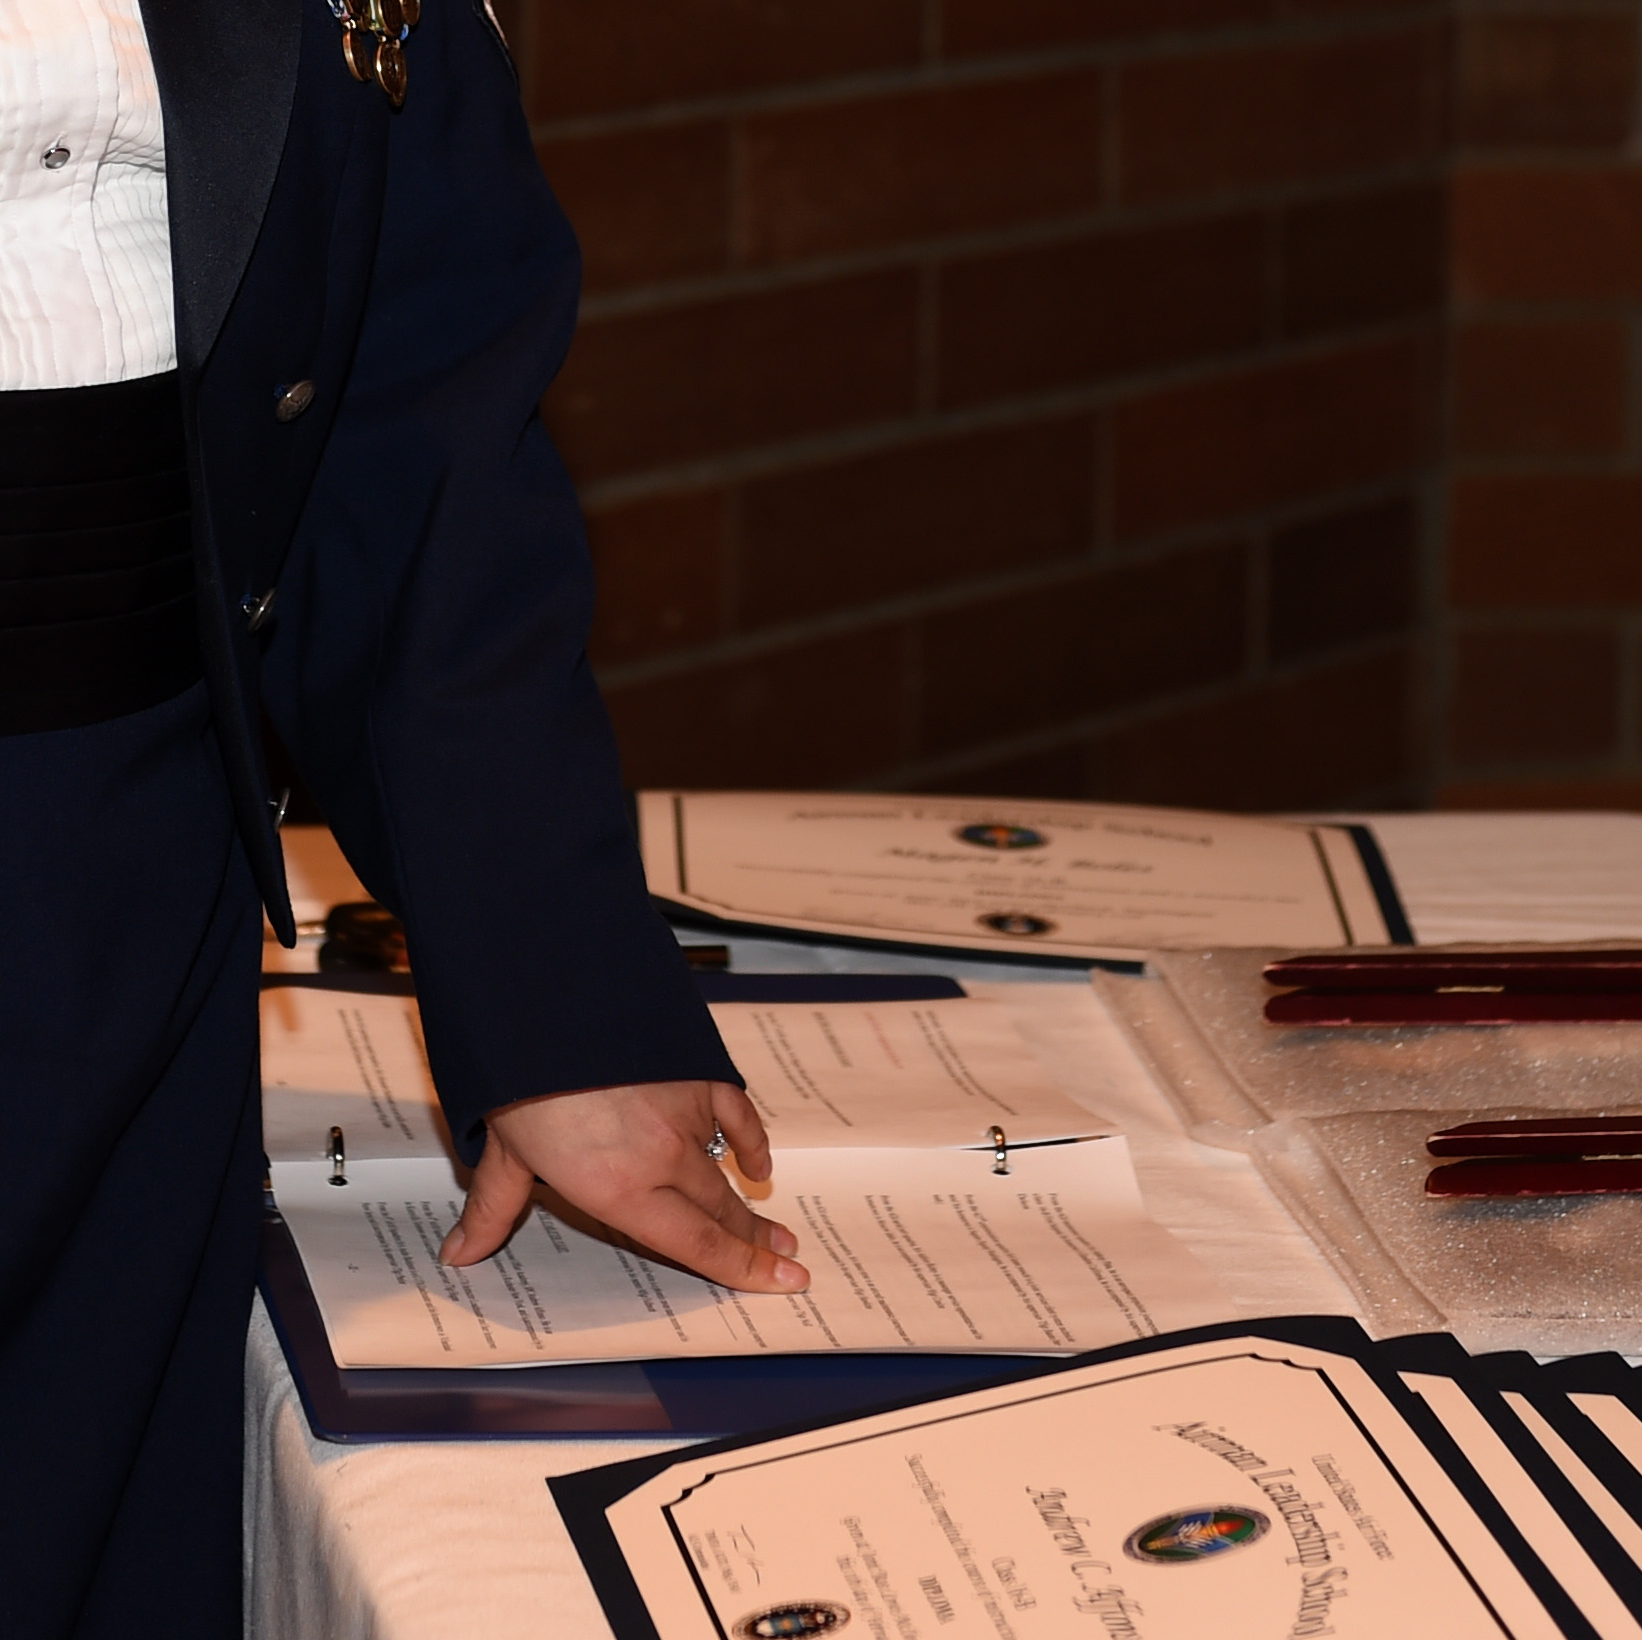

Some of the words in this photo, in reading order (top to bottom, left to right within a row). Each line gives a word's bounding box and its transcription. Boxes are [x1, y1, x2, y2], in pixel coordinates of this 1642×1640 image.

[1151, 1420, 1267, 1473] Airman
[1025, 1485, 1092, 1558] Andrew
[1248, 1466, 1345, 1568] Leadership
[918, 1573, 956, 1625] DIPLOMA
[1286, 1566, 1349, 1640] School
